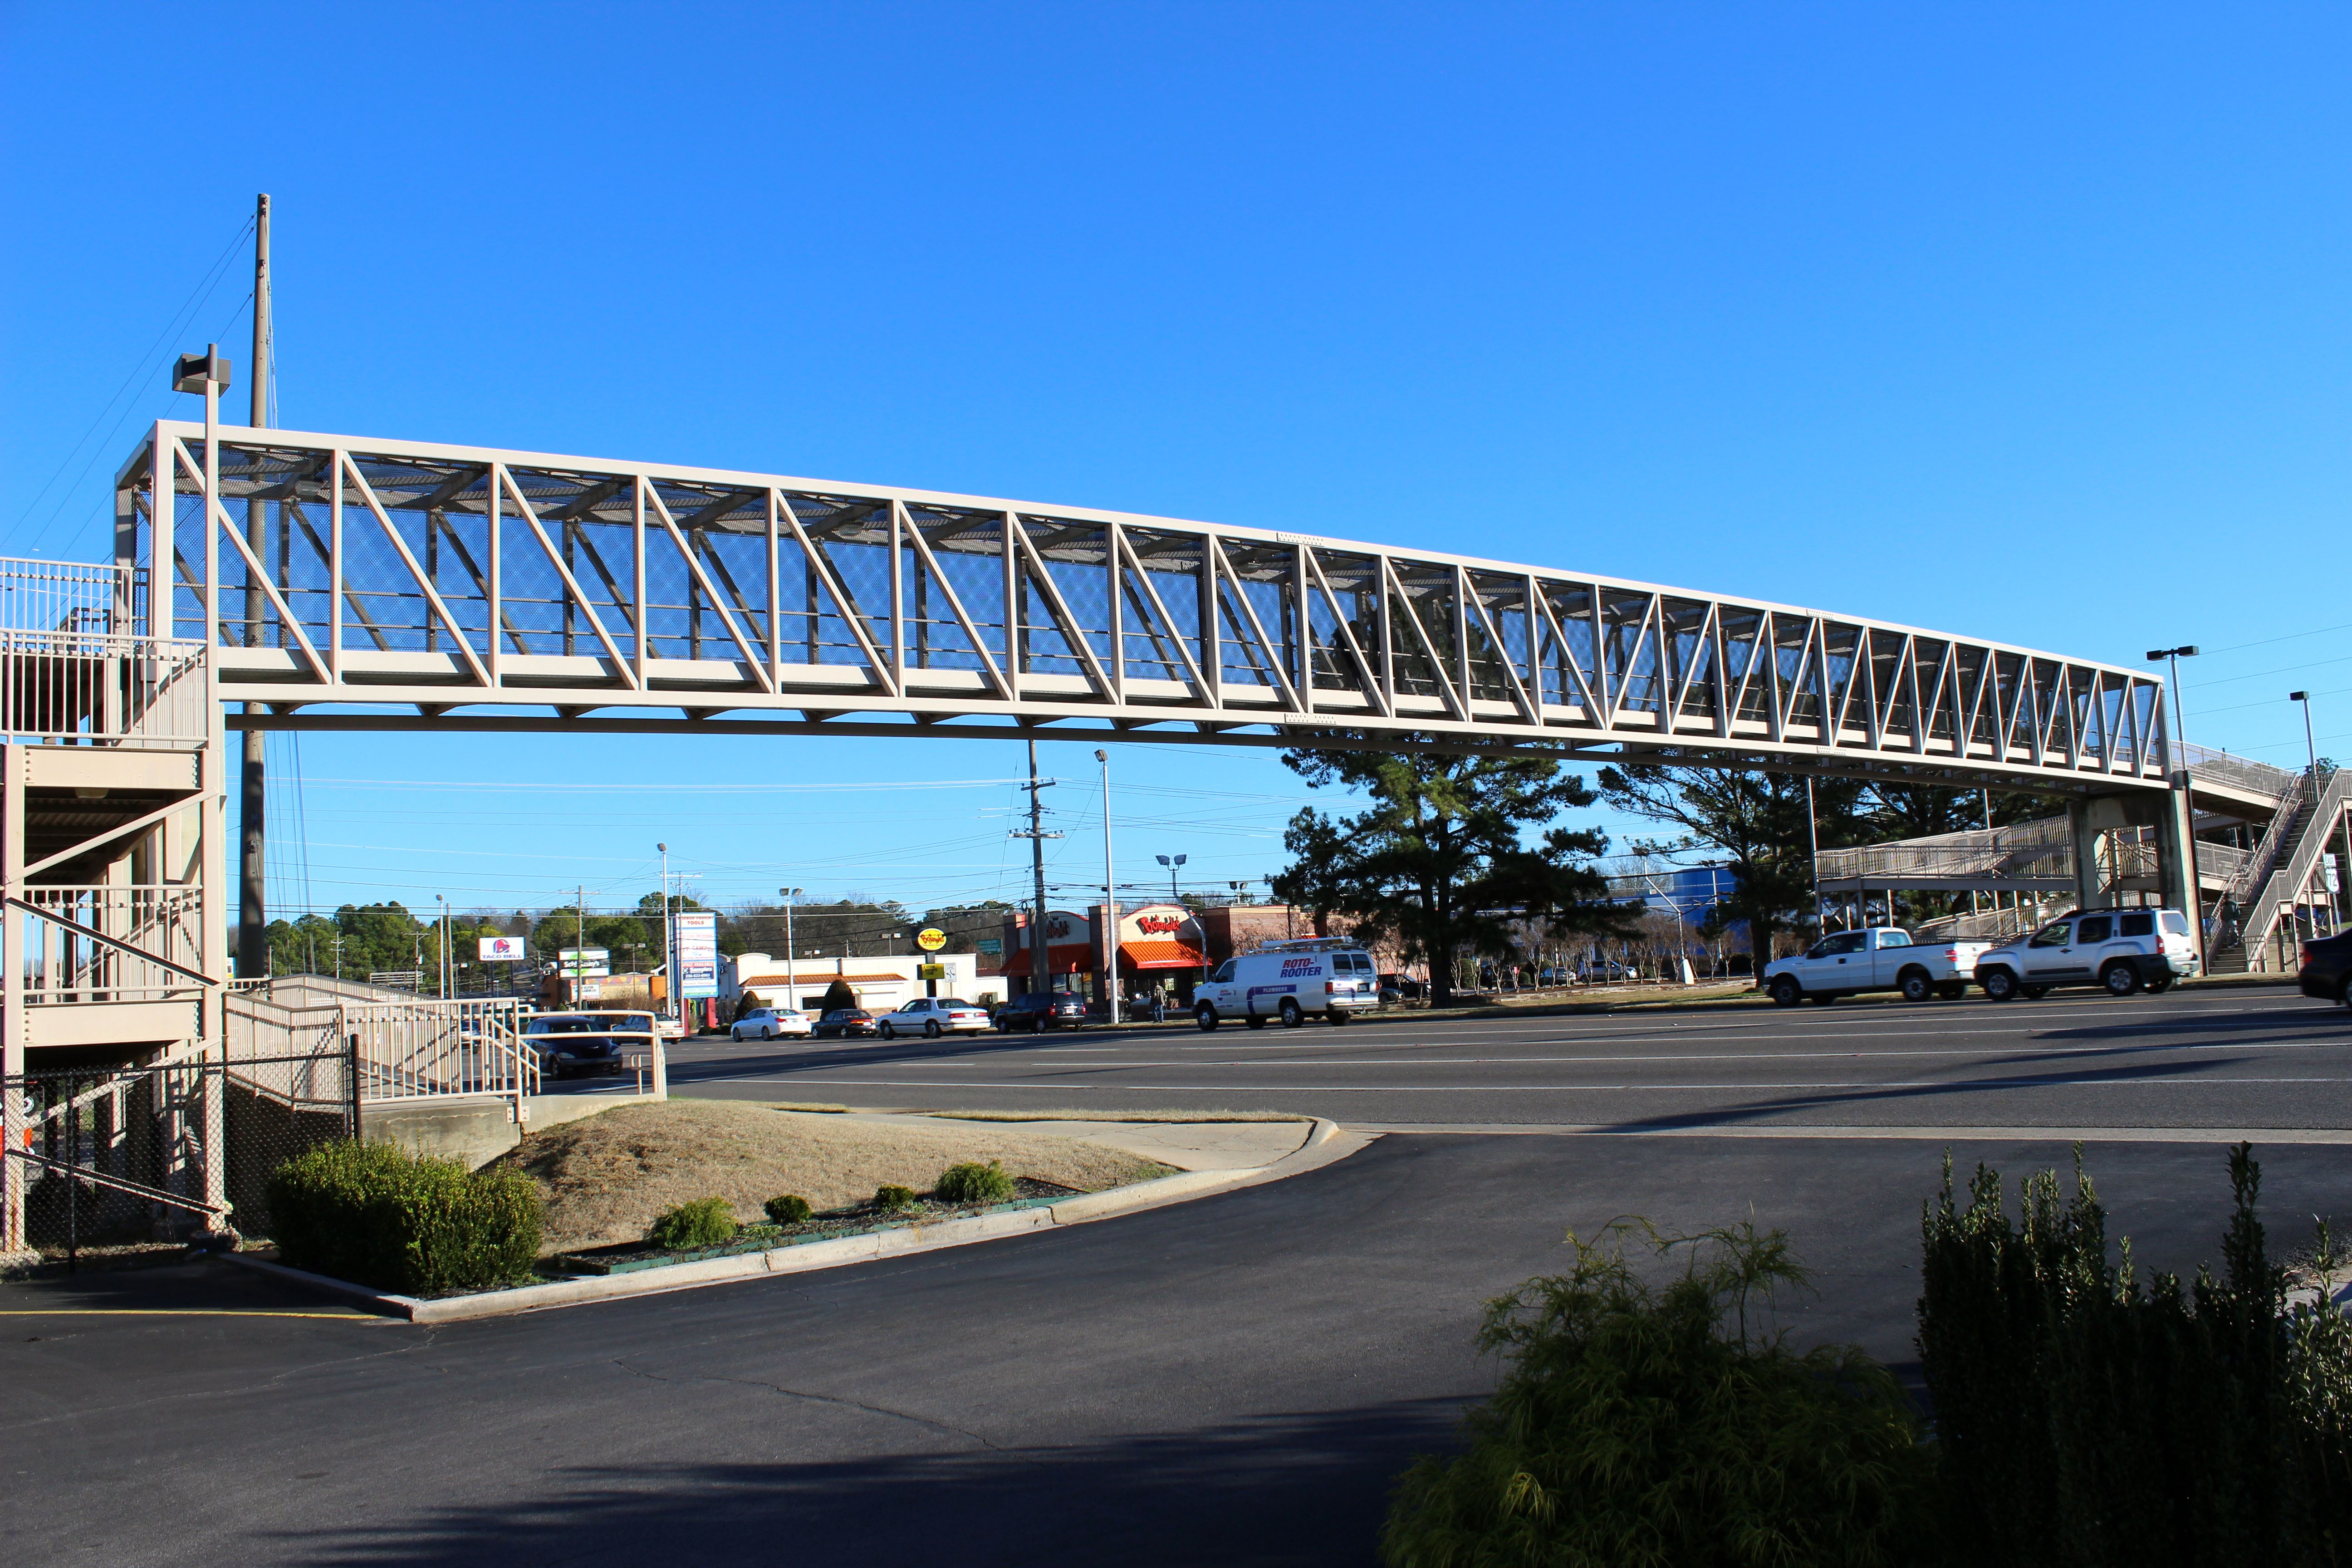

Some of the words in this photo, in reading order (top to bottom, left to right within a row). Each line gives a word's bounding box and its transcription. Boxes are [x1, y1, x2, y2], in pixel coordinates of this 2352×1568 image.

[2327, 873, 2337, 887] 72
[1283, 958, 1314, 968] ROTO-
[1280, 966, 1322, 978] ROOTER
